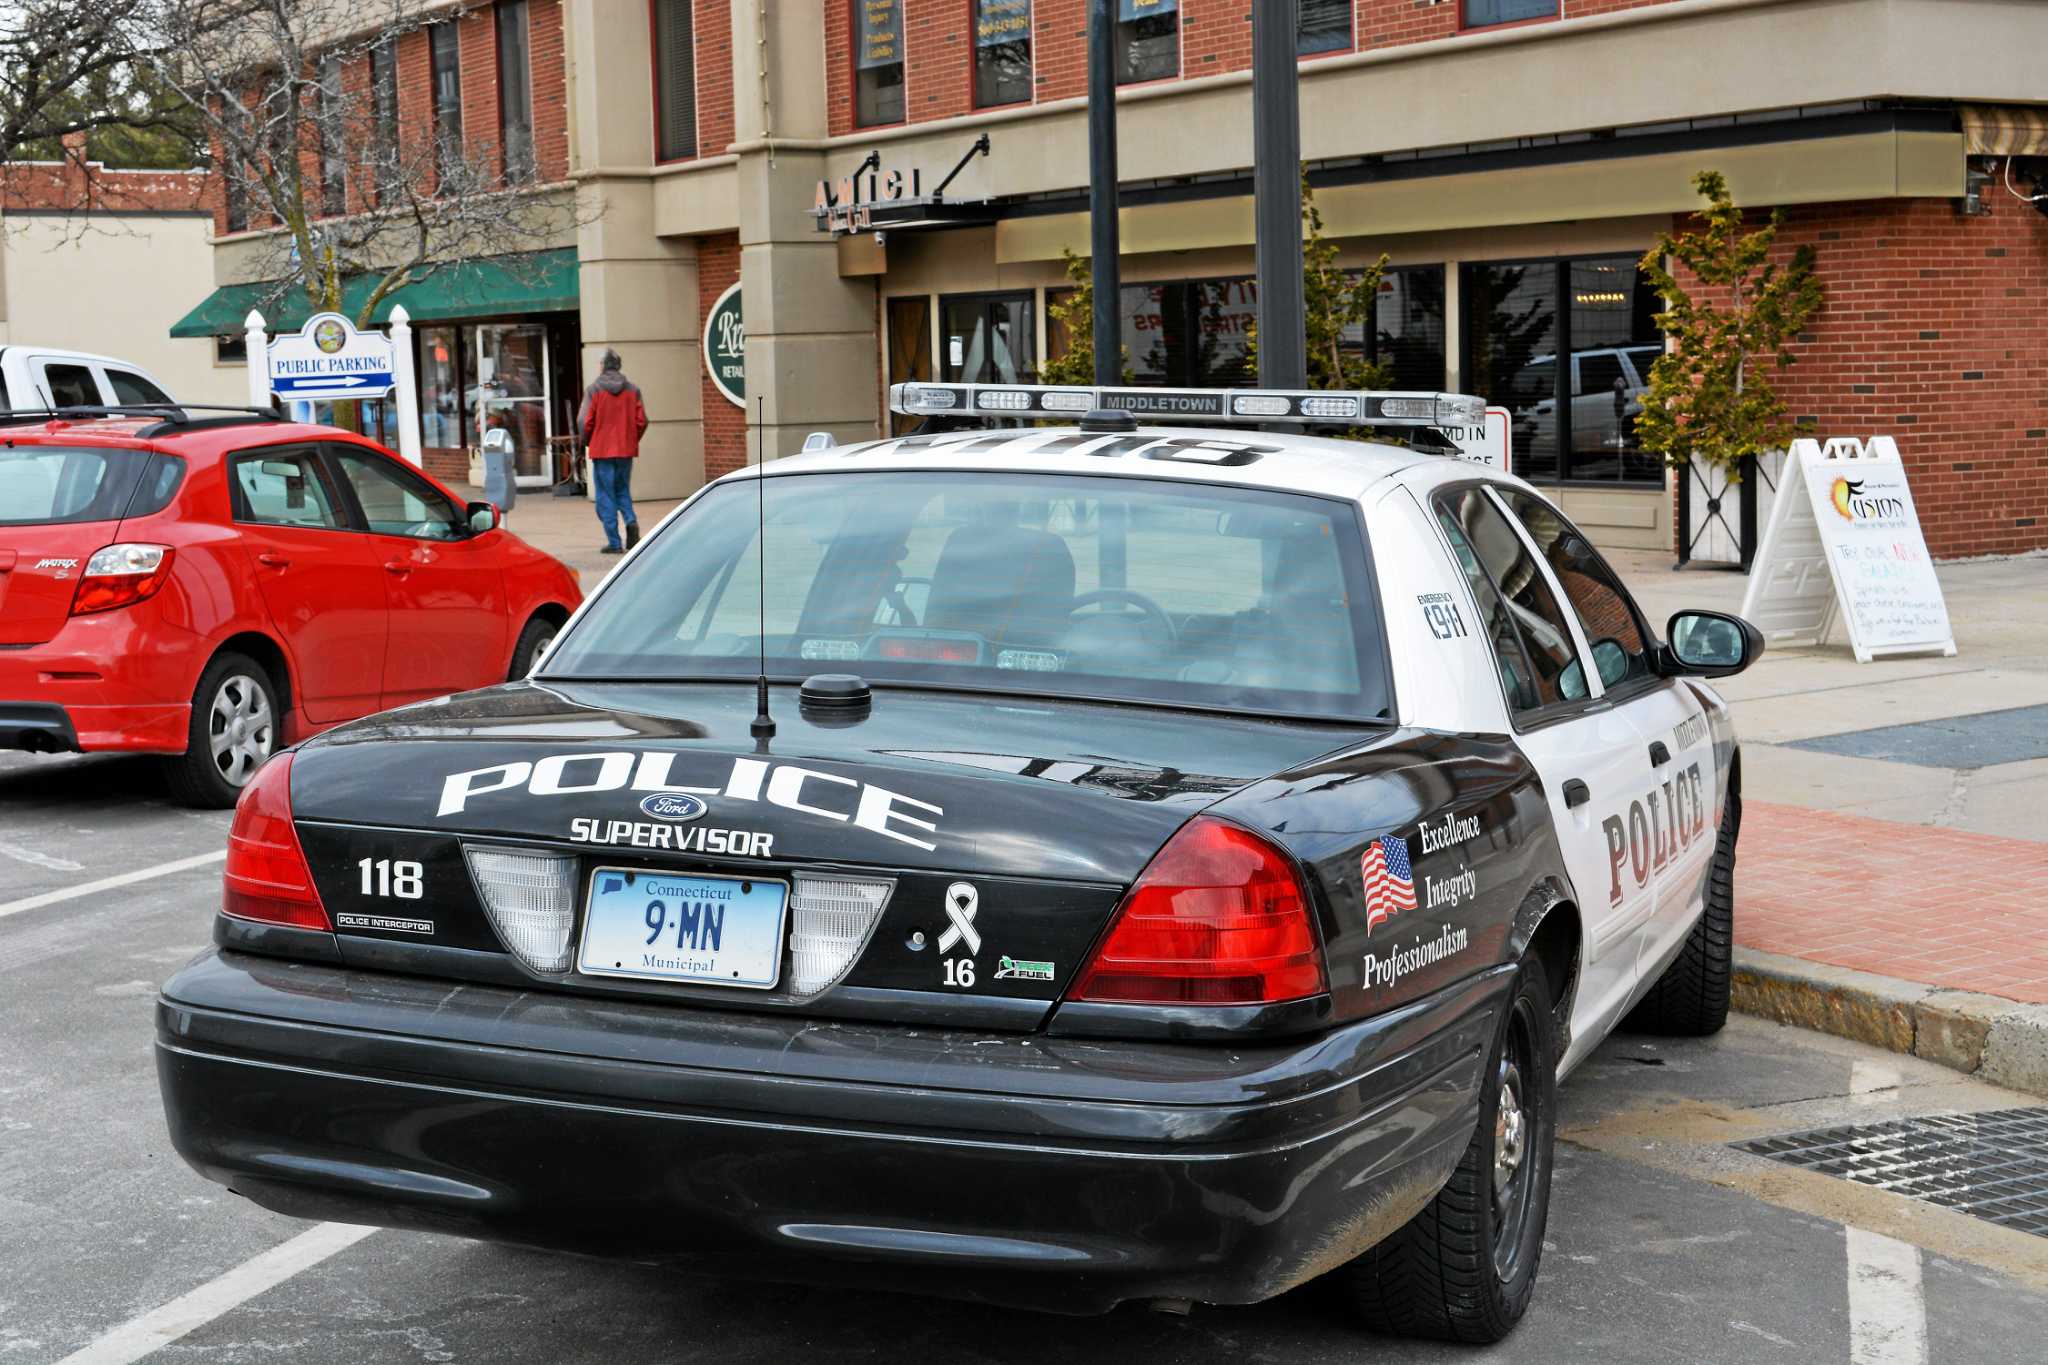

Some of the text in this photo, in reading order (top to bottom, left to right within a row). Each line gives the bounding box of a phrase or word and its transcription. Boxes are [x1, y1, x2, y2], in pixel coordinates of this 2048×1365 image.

[277, 356, 386, 374] PUBLIC PARKING
[1107, 396, 1216, 410] MIDDLETOWN
[34, 559, 79, 569] MATRIX
[436, 752, 943, 851] POLICE
[654, 797, 690, 814] Ford
[569, 817, 774, 857] SUPERVISOR
[1418, 812, 1480, 854] Excellence
[1602, 762, 1703, 908] POLICE
[358, 857, 423, 899] 118
[646, 880, 732, 900] Connecticut
[1425, 863, 1476, 908] Integrity
[340, 916, 431, 931] POLICE INTERCEPTOR
[642, 954, 715, 973] Municipal
[1363, 922, 1468, 990] Professionalism
[943, 958, 975, 987] 16
[1019, 970, 1051, 979] FUEL
